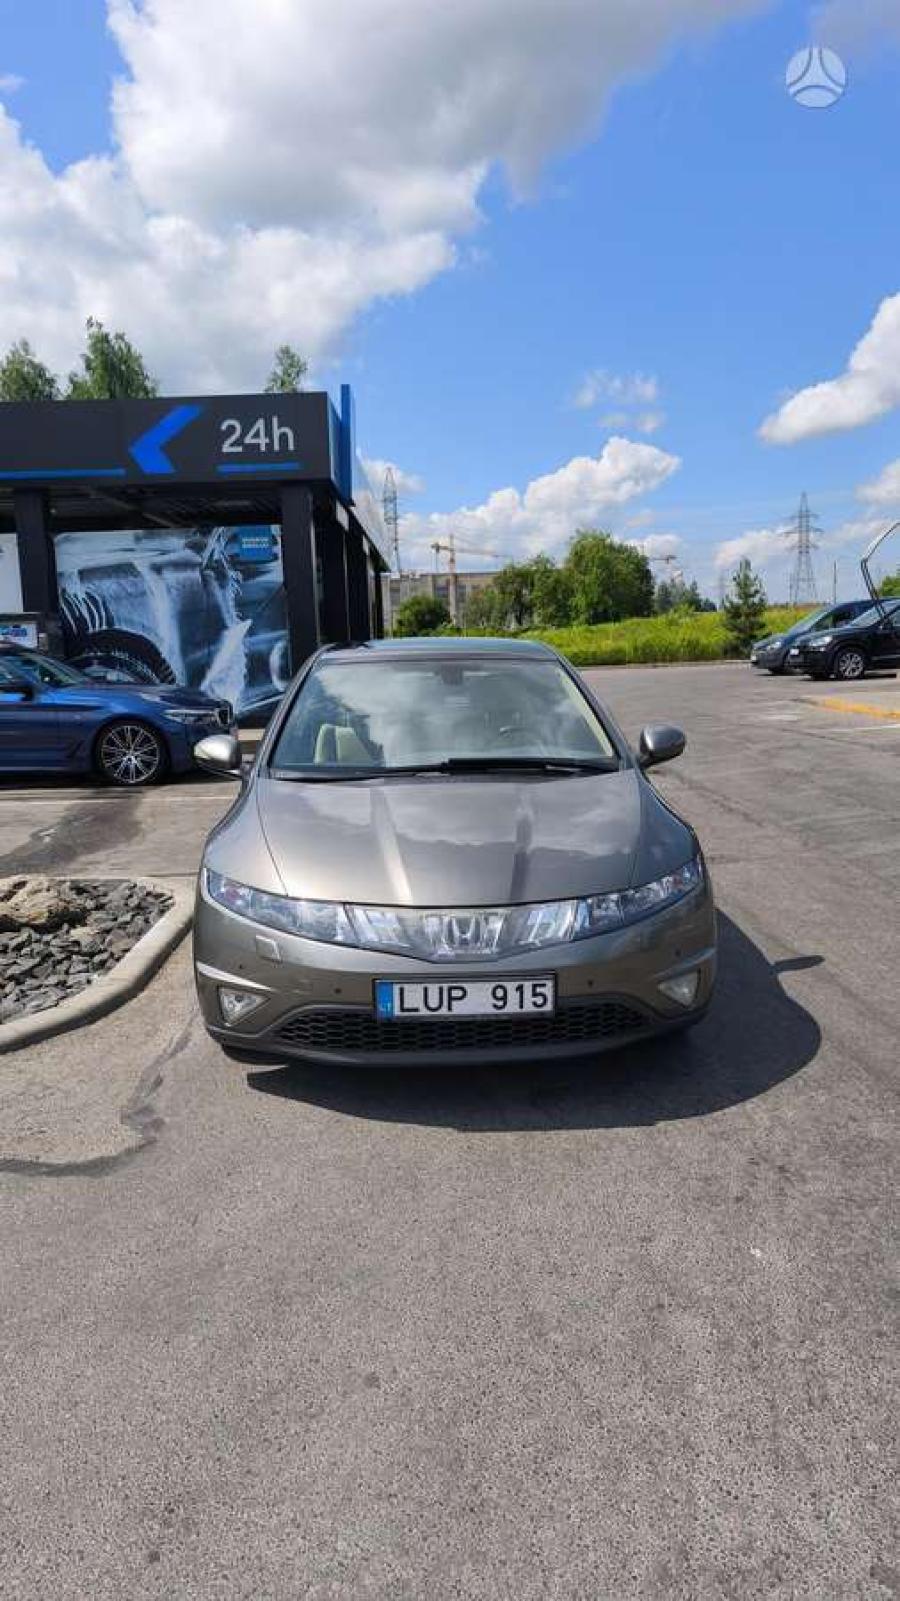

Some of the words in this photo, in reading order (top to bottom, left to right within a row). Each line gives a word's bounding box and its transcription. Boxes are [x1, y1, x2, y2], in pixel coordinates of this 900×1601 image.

[221, 416, 294, 452] 24h
[399, 985, 467, 1013] LUP
[491, 983, 548, 1010] 915
